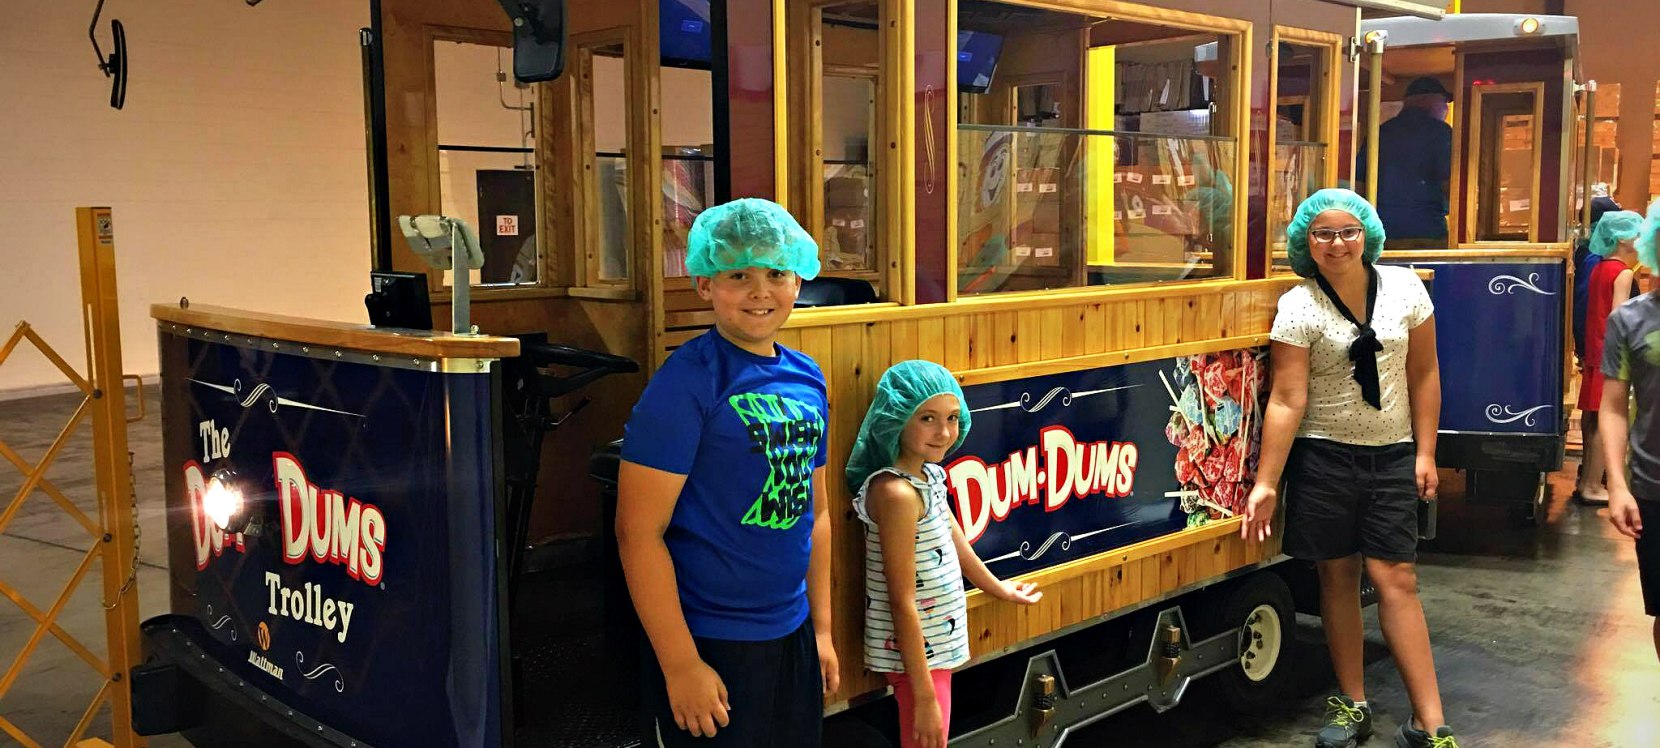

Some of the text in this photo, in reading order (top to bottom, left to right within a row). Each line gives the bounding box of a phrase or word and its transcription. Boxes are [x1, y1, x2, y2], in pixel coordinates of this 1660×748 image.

[499, 225, 515, 233] EXIT
[503, 217, 512, 225] TO
[200, 418, 231, 463] The
[272, 451, 387, 586] DUMS
[265, 571, 354, 643] Trolley
[248, 650, 284, 681] Wattman
